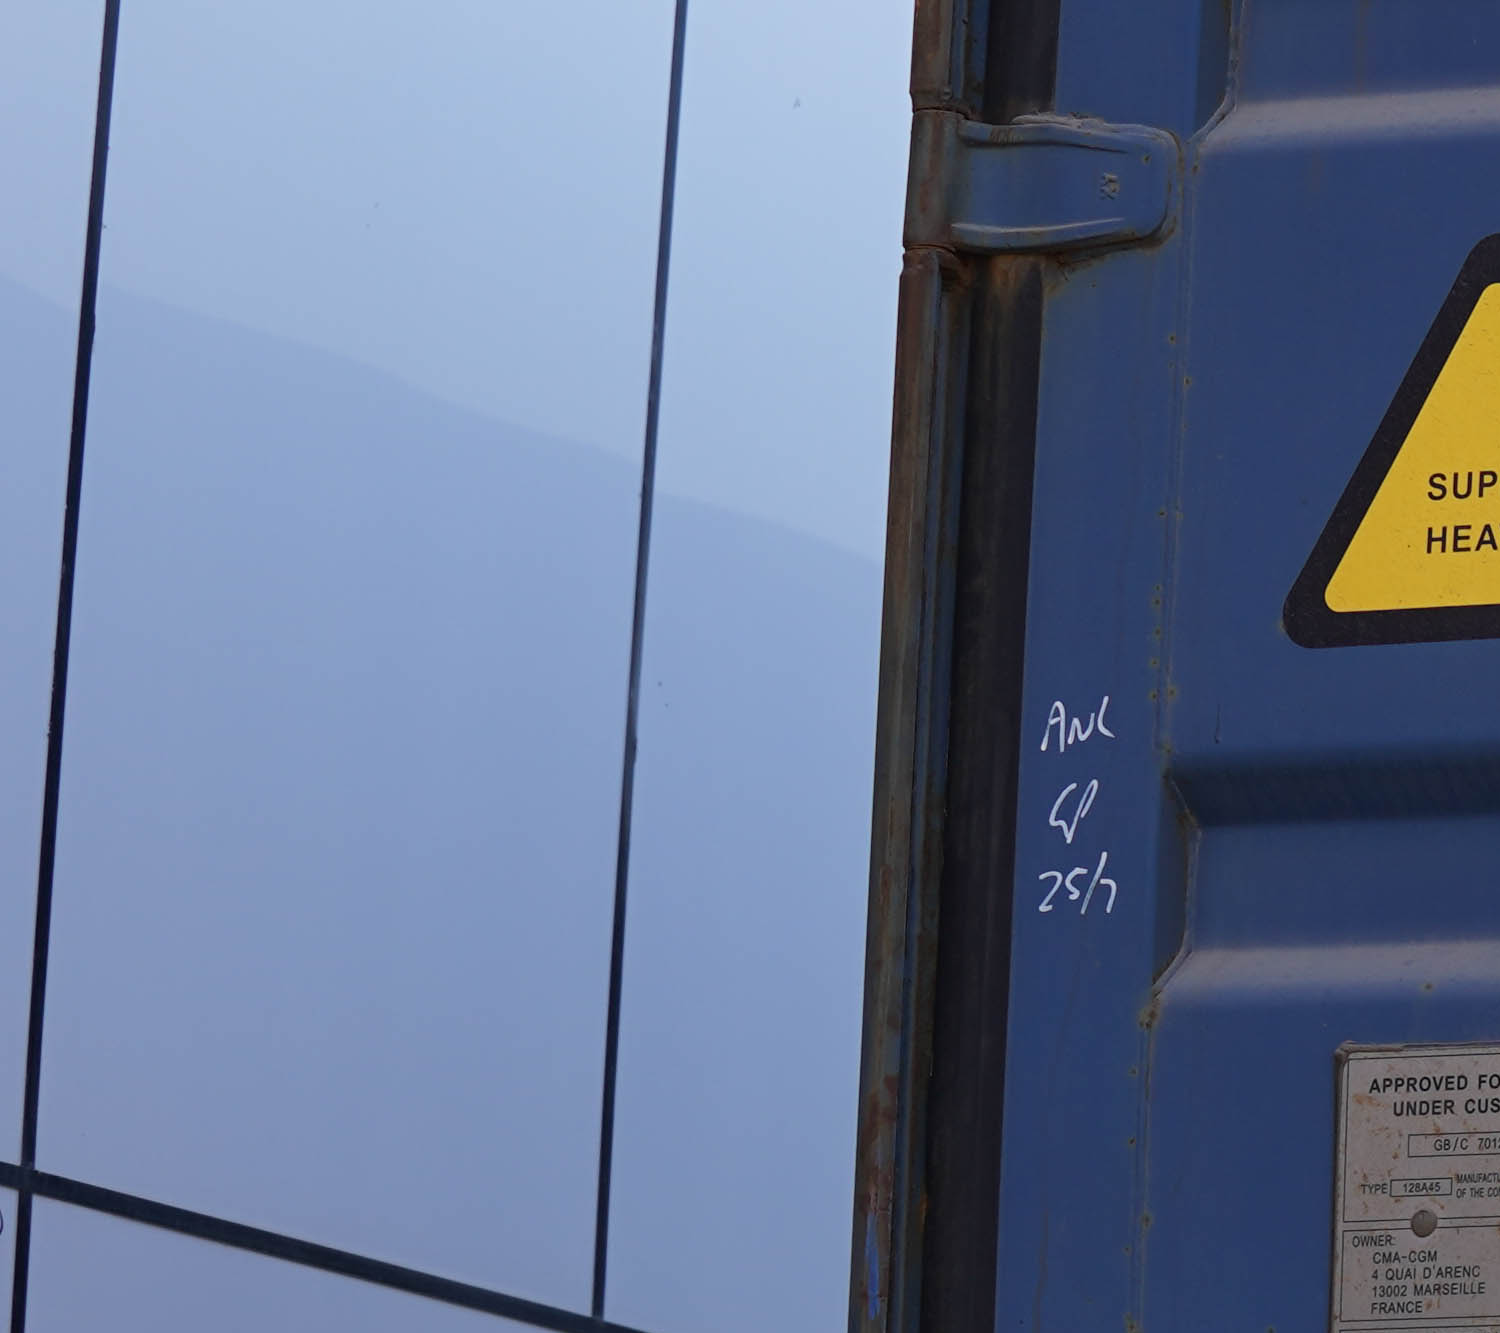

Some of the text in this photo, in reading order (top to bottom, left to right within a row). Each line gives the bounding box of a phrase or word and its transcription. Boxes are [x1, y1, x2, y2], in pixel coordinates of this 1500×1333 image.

[1369, 1075, 1468, 1093] APPROVED
[1394, 1100, 1454, 1116] UNDER
[1434, 1137, 1469, 1152] GB/C
[1361, 1183, 1388, 1194] TYPE
[1373, 1251, 1437, 1264] CMA-CGM
[1372, 1266, 1480, 1280] 4 QUAI D'ARENC
[1372, 1282, 1486, 1297] 13002 MARSEILLE
[1371, 1301, 1422, 1314] FRANCE
